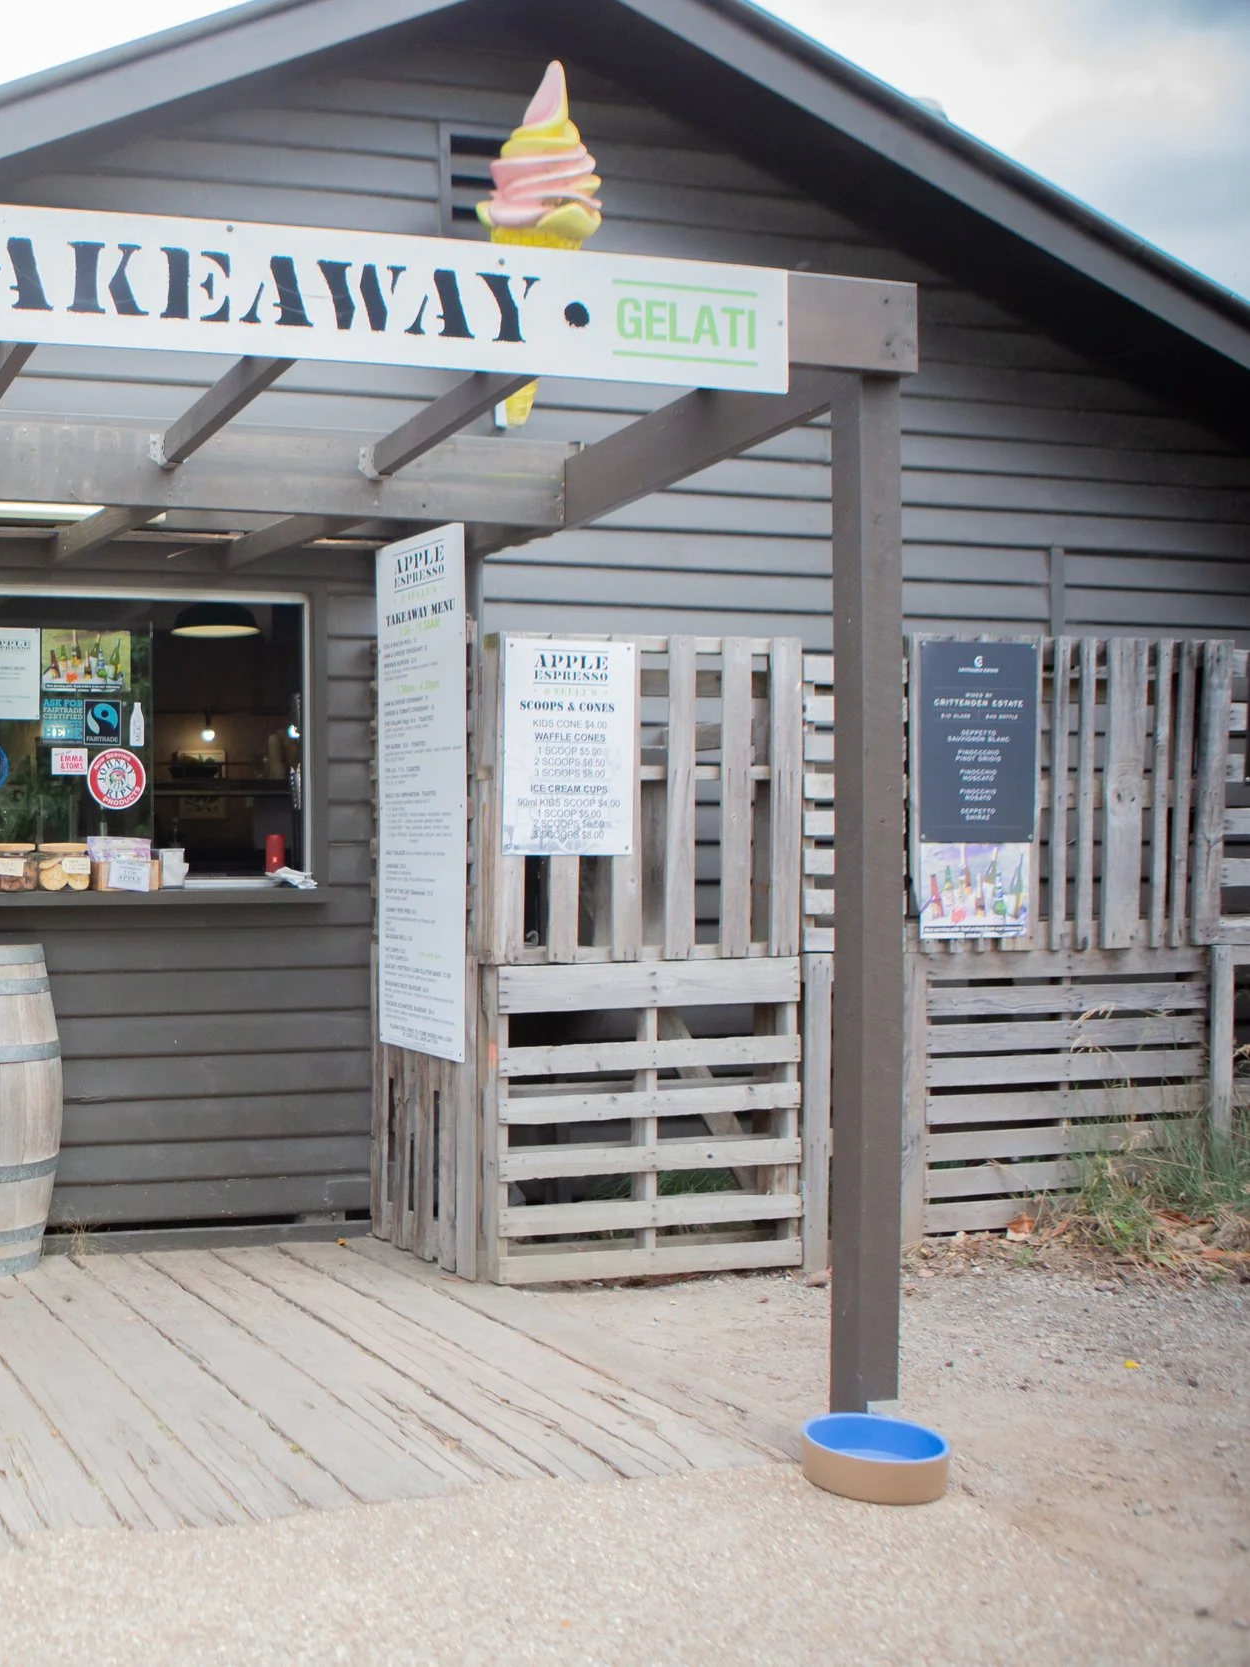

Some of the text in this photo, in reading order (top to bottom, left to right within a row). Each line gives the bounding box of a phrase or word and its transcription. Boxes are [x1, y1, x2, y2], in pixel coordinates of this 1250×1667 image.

[616, 297, 756, 350] GELATI
[394, 544, 445, 576] APPLE
[394, 563, 445, 589] ESPRESSO
[385, 597, 456, 627] TAKEAWAY MENU
[534, 653, 609, 671] APPLE
[534, 669, 609, 682] ESPRESSO
[43, 699, 83, 707] ASK FOR
[519, 700, 615, 713] SCOOPS & CONES
[933, 698, 1024, 708] CRITTENDEN ESTATE
[533, 719, 608, 730] KIDS CONE $4.00
[534, 732, 606, 742] WAFFLE CONES
[947, 735, 986, 743] SAUVIGNON
[544, 746, 578, 756] SCOOP
[579, 746, 603, 757] $5.00
[94, 752, 131, 770] NOW SERVING
[534, 757, 606, 768] 2 SCOOPS $6.50
[977, 755, 1002, 763] GRIGIO
[98, 759, 134, 783] JOHNNY
[534, 768, 606, 780] 3 SCOOPS $8.00
[530, 784, 608, 794] ICE CREAM CUPS
[102, 786, 141, 806] PRODUCTS
[540, 799, 561, 807] KIDS
[563, 799, 596, 808] SCOOP
[598, 799, 621, 808] $4.00
[544, 809, 577, 818] SCOOP
[579, 809, 602, 819] $5.00
[533, 820, 539, 828] 2
[541, 820, 580, 829] SCOOPS
[533, 830, 605, 841] 3 SCOOPS $8.00
